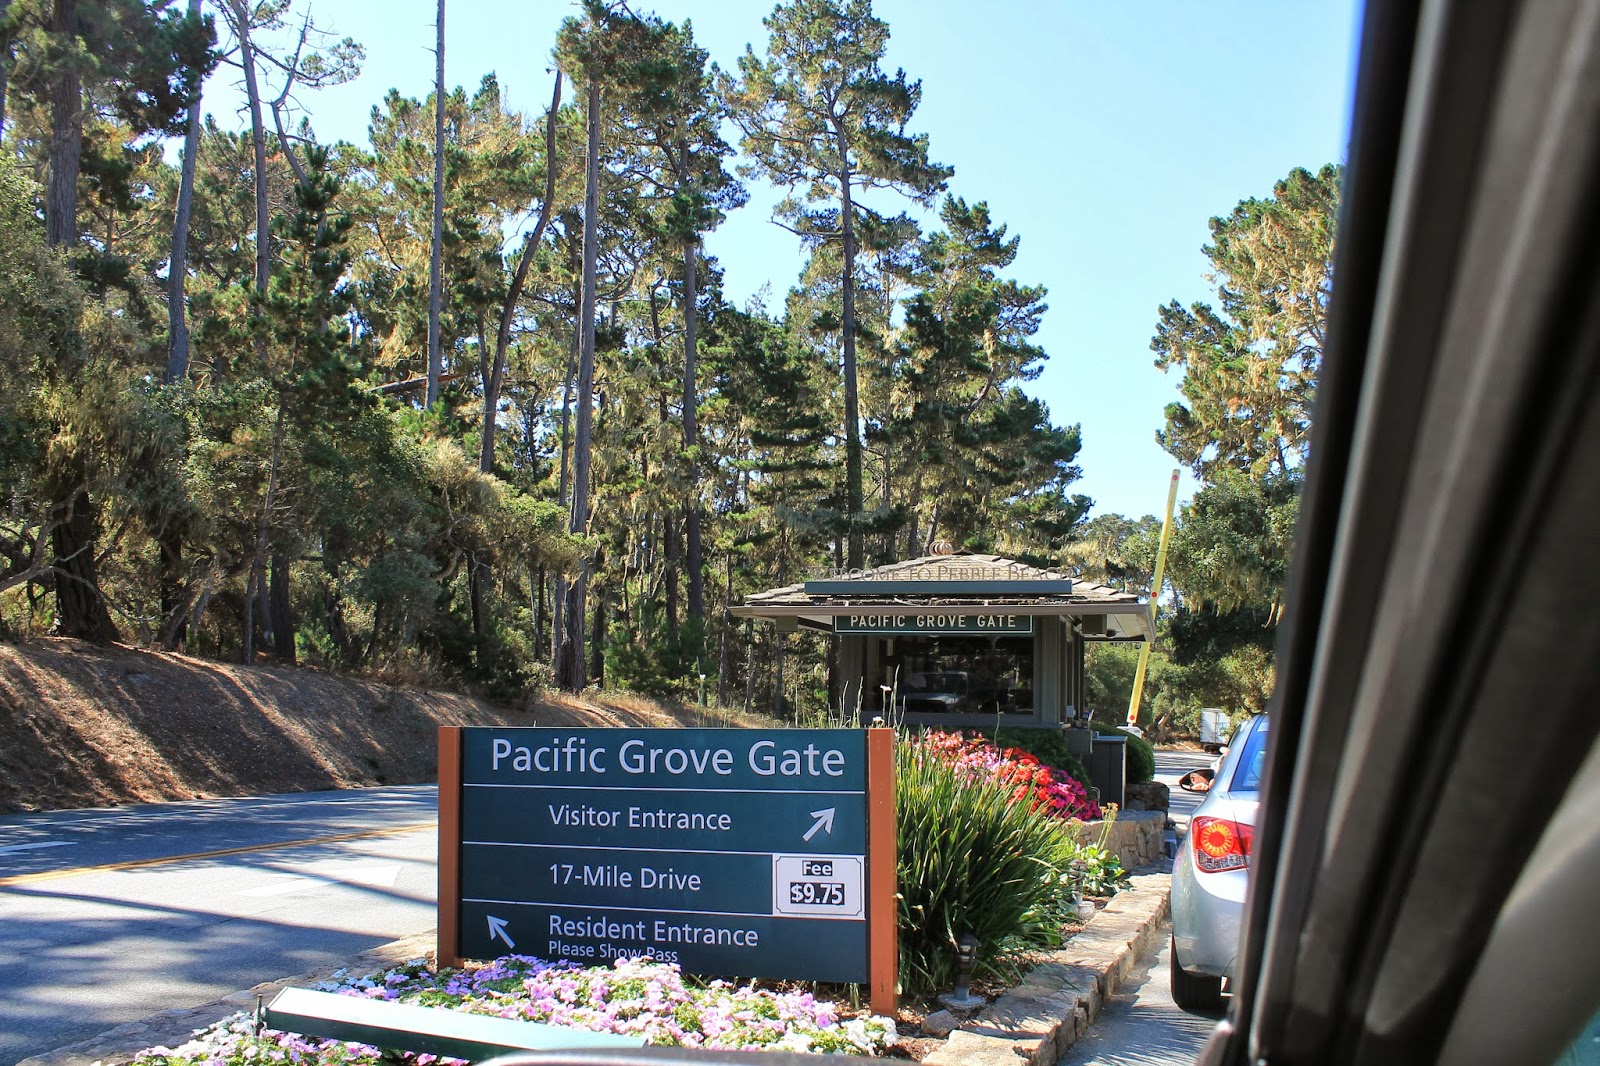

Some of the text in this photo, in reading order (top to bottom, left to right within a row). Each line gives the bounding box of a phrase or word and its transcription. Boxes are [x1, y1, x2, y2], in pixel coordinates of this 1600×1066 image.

[905, 567, 932, 581] TO
[937, 565, 1001, 580] PEBBLE
[850, 615, 1016, 628] PACIFIC GROVE GATE
[492, 737, 845, 776] Pacific Grove Gate
[548, 804, 732, 831] Visitor Entrance
[550, 863, 701, 891] 17-Mile Drive
[803, 861, 831, 876] Fee
[791, 883, 843, 905] $9.75
[549, 914, 759, 947] Resident Entrance
[549, 940, 678, 963] Please Show Pass
